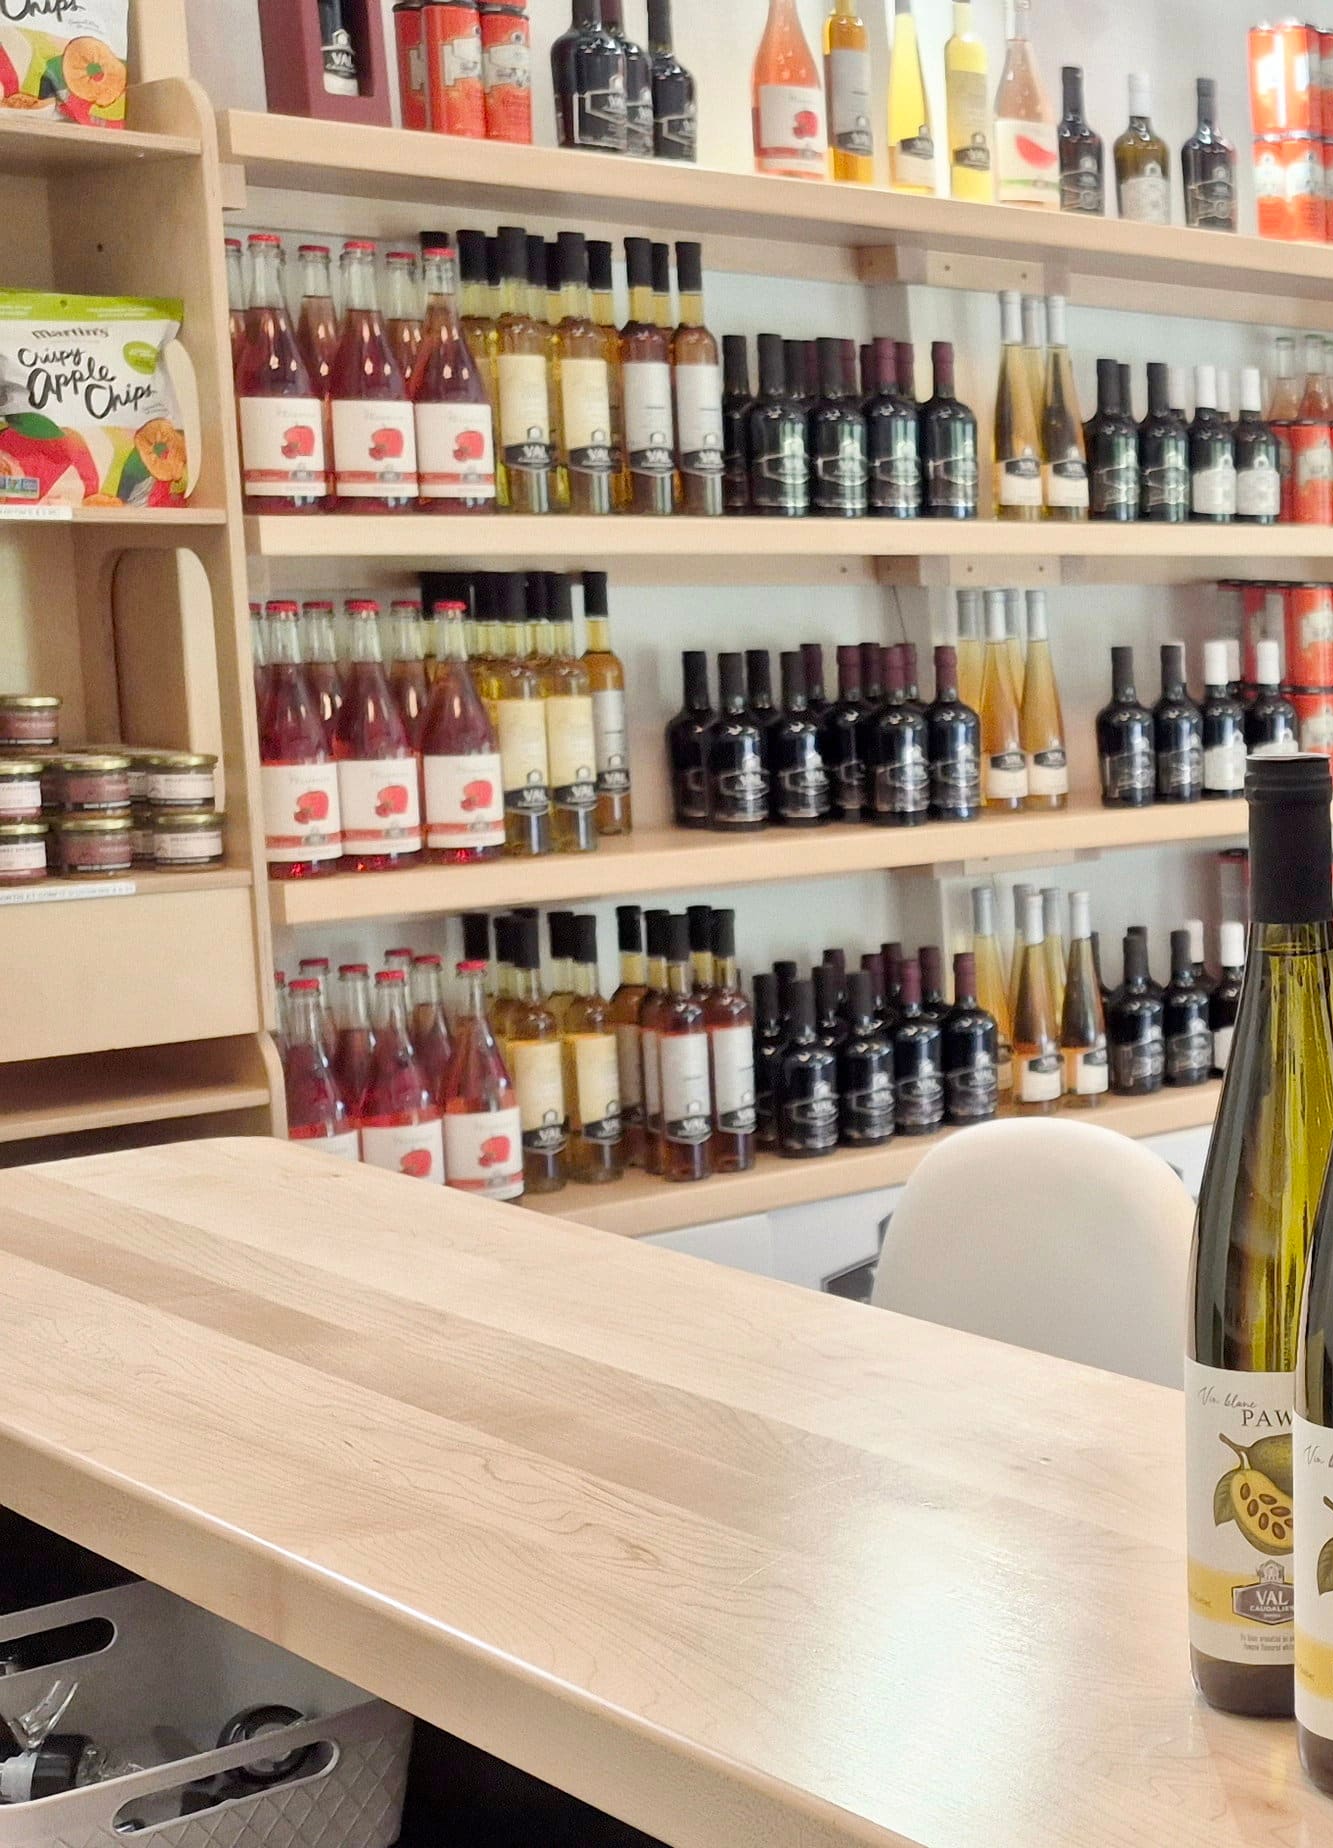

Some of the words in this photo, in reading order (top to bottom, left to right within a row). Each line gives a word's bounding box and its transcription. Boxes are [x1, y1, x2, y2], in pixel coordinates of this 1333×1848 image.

[18, 347, 84, 368] Crispy
[27, 356, 116, 410] Apple
[85, 383, 156, 420] Chips
[1241, 1409, 1293, 1427] PAW
[1256, 1590, 1289, 1605] VAL
